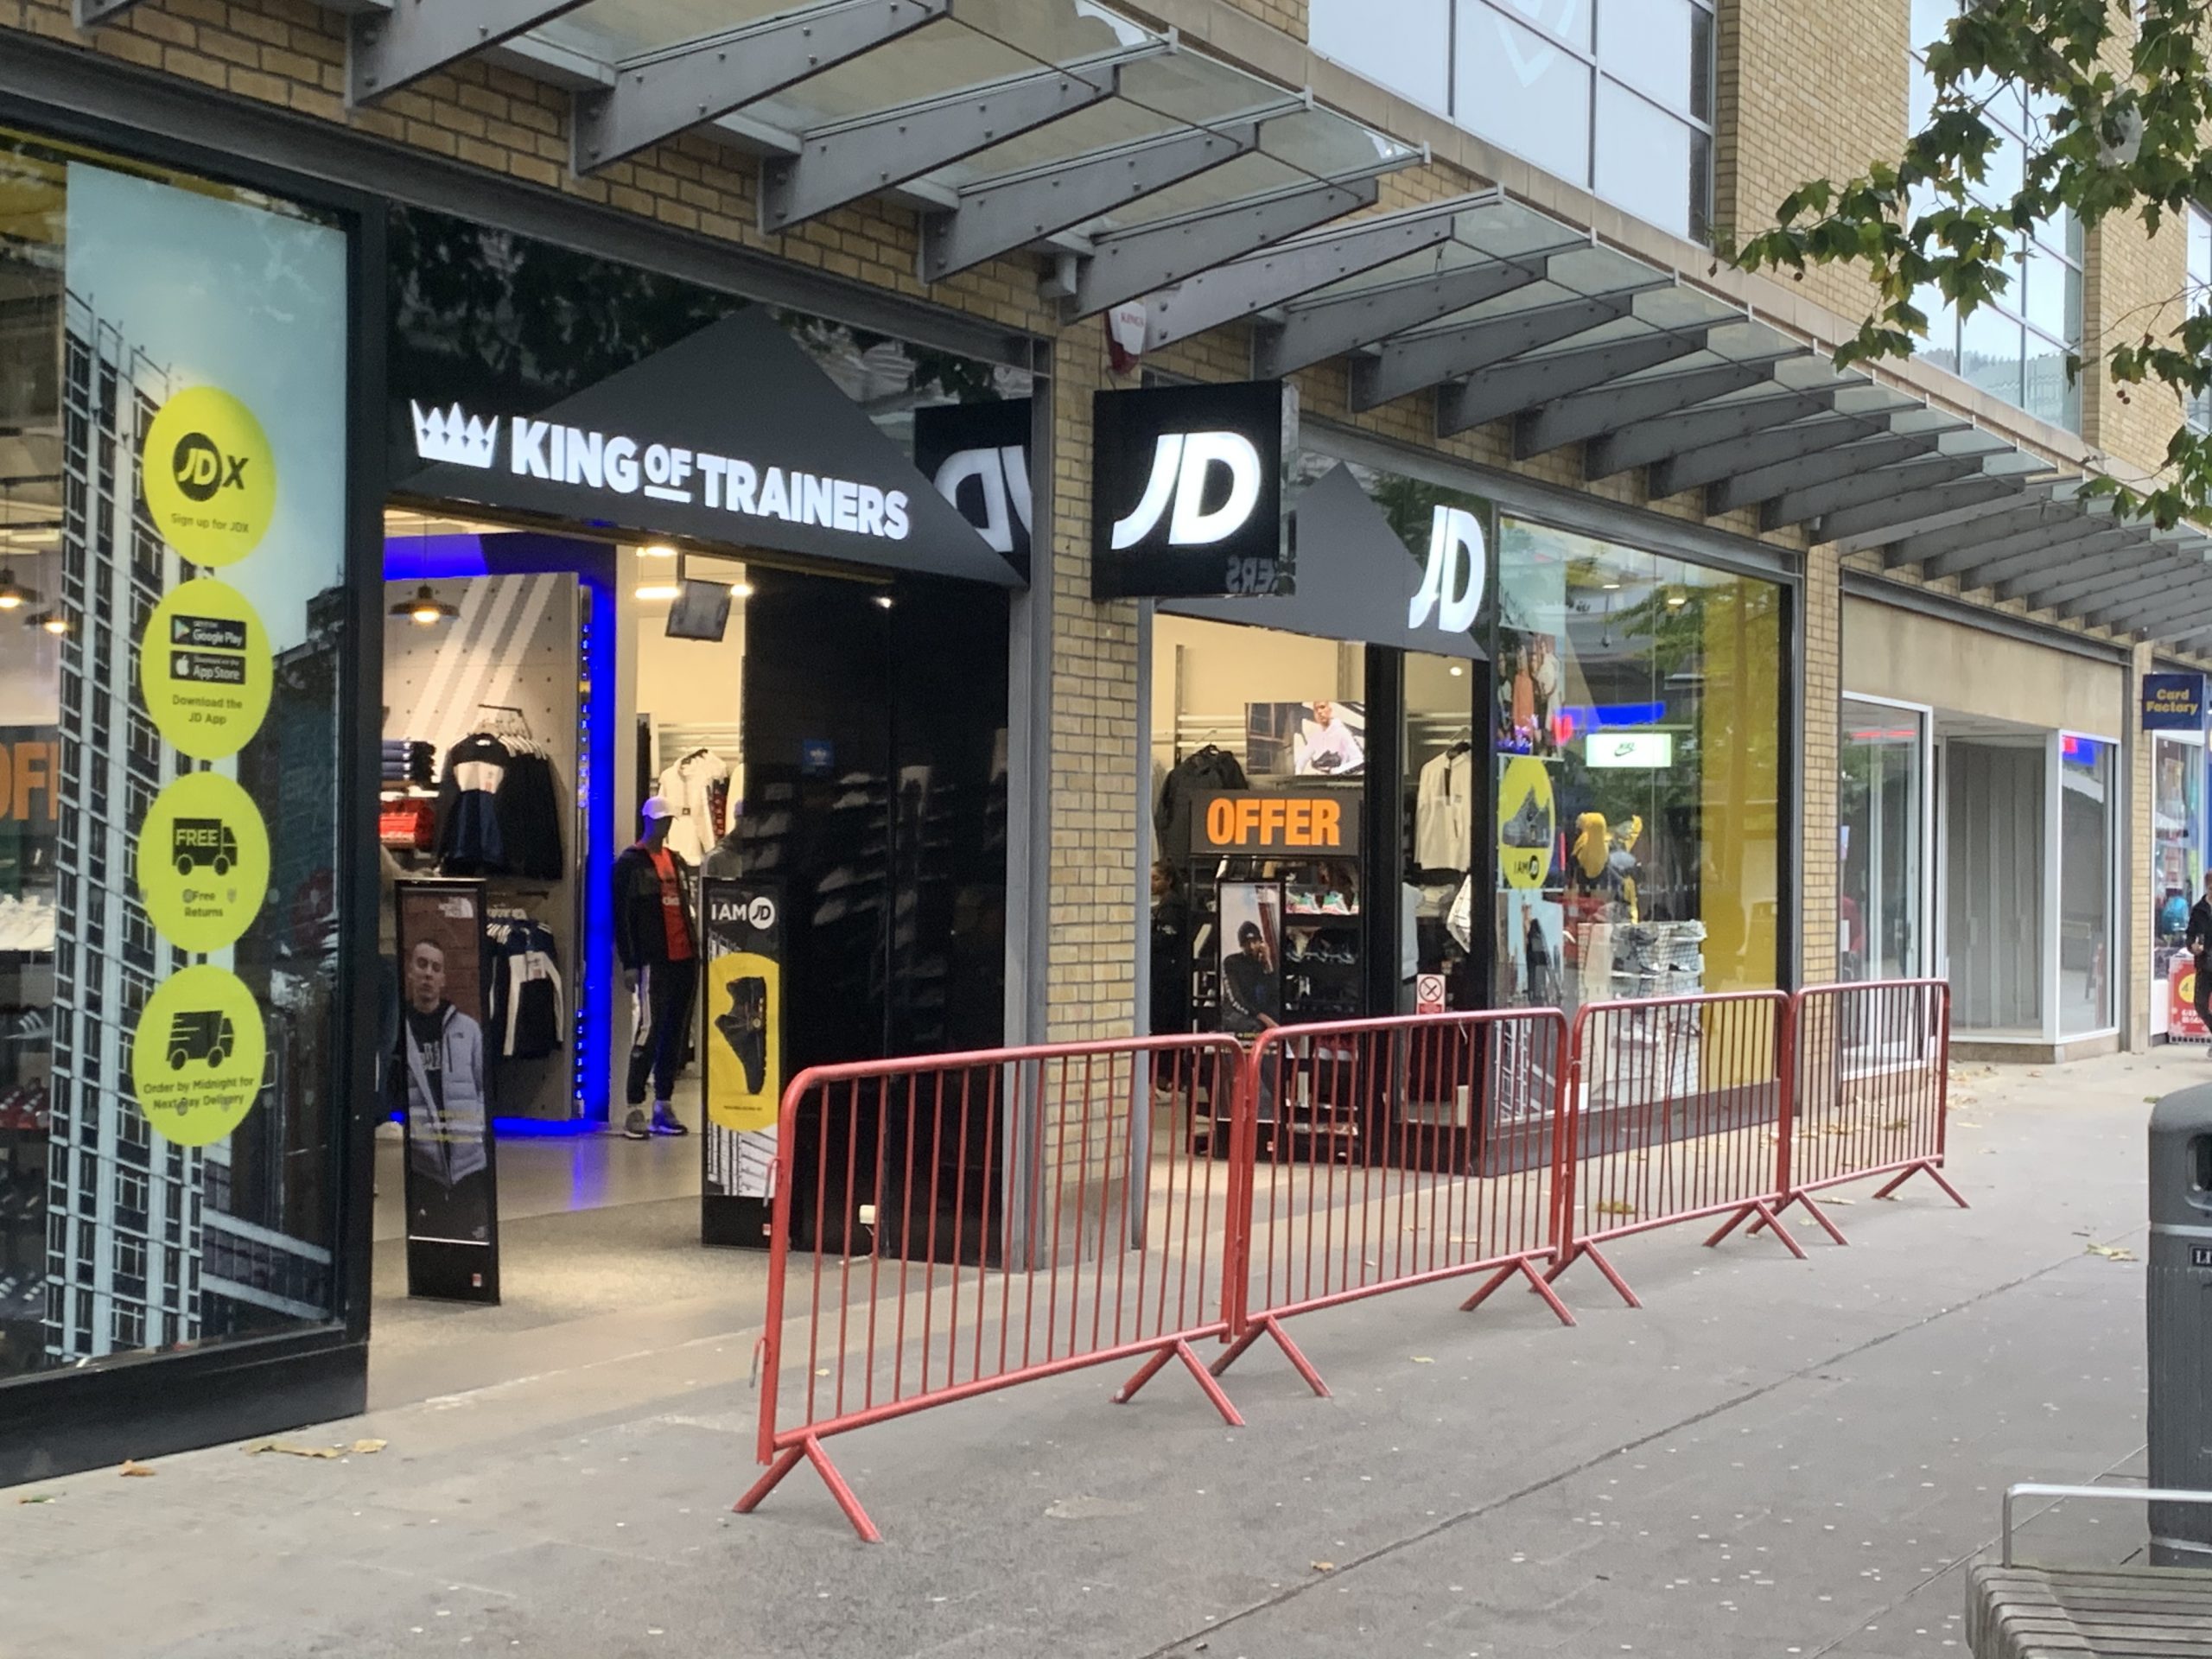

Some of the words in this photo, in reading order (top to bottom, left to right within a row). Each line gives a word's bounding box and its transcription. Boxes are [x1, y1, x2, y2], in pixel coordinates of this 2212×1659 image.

[512, 416, 639, 493] KING
[644, 443, 691, 487] OF
[696, 453, 909, 540] TRAINERS
[1111, 431, 1262, 550] JD
[171, 513, 194, 527] Sign
[196, 518, 210, 529] up
[213, 518, 226, 530] for
[230, 521, 249, 533] JDX
[1408, 505, 1486, 633] JD
[193, 629, 224, 645] Google
[225, 632, 243, 646] Play
[193, 664, 213, 680] App
[214, 666, 240, 681] Store
[173, 694, 224, 708] Download
[226, 698, 243, 709] the
[2157, 689, 2190, 700] Card
[2145, 701, 2199, 715] Factory
[188, 712, 202, 722] JD
[205, 714, 227, 725] App
[1206, 798, 1340, 846] OFFER
[175, 830, 219, 847] FREE
[192, 891, 216, 901] Free
[184, 906, 223, 917] Returns
[712, 904, 716, 920] I
[718, 903, 747, 921] AM
[143, 1084, 174, 1094] Order
[177, 1082, 189, 1092] by
[193, 1077, 236, 1090] Midnight
[240, 1077, 254, 1087] for
[153, 1100, 176, 1110] Next
